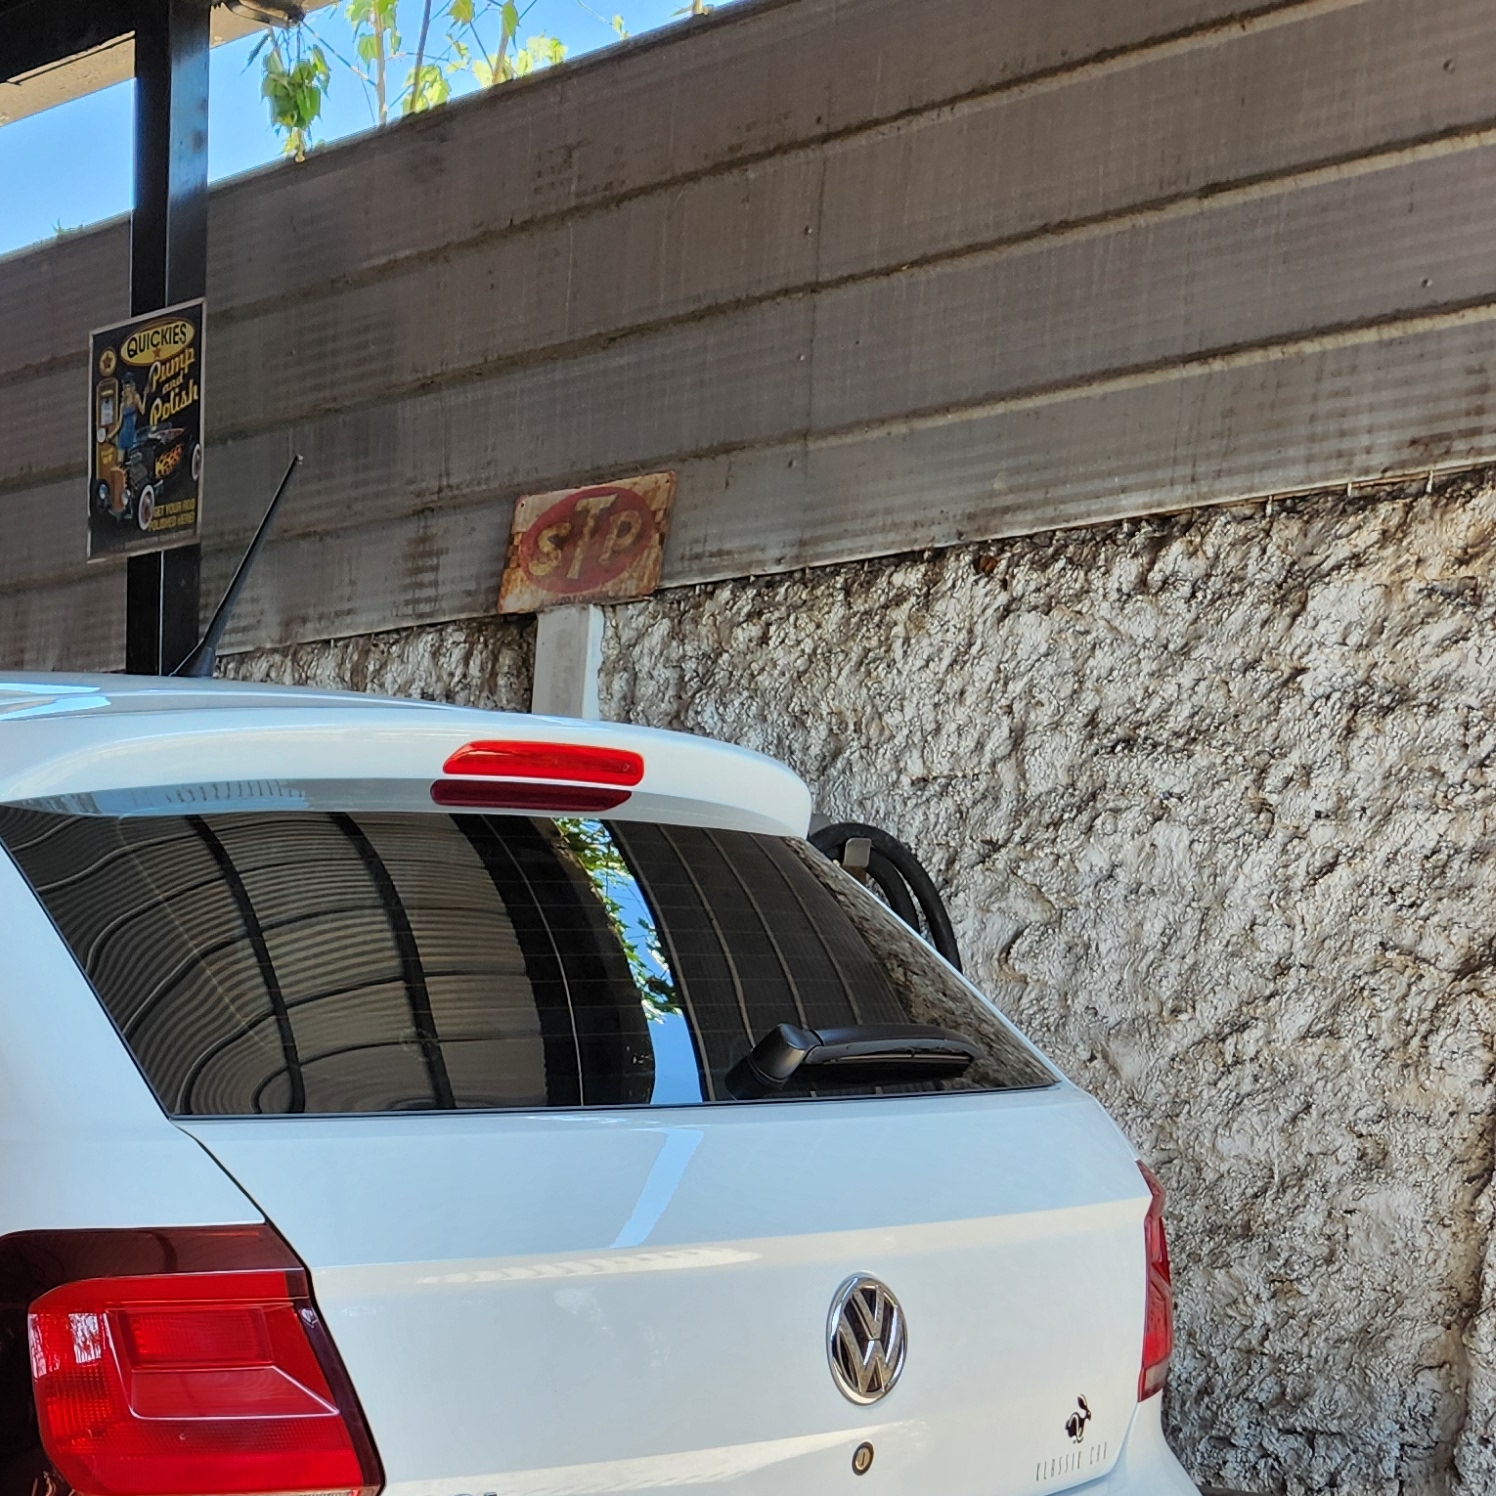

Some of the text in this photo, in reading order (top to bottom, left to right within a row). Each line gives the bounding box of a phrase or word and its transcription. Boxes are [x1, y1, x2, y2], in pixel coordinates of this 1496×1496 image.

[126, 322, 187, 360] QUICKIES
[148, 347, 196, 392] Pump
[161, 370, 184, 395] and
[149, 379, 199, 426] Polish
[529, 493, 642, 580] STP
